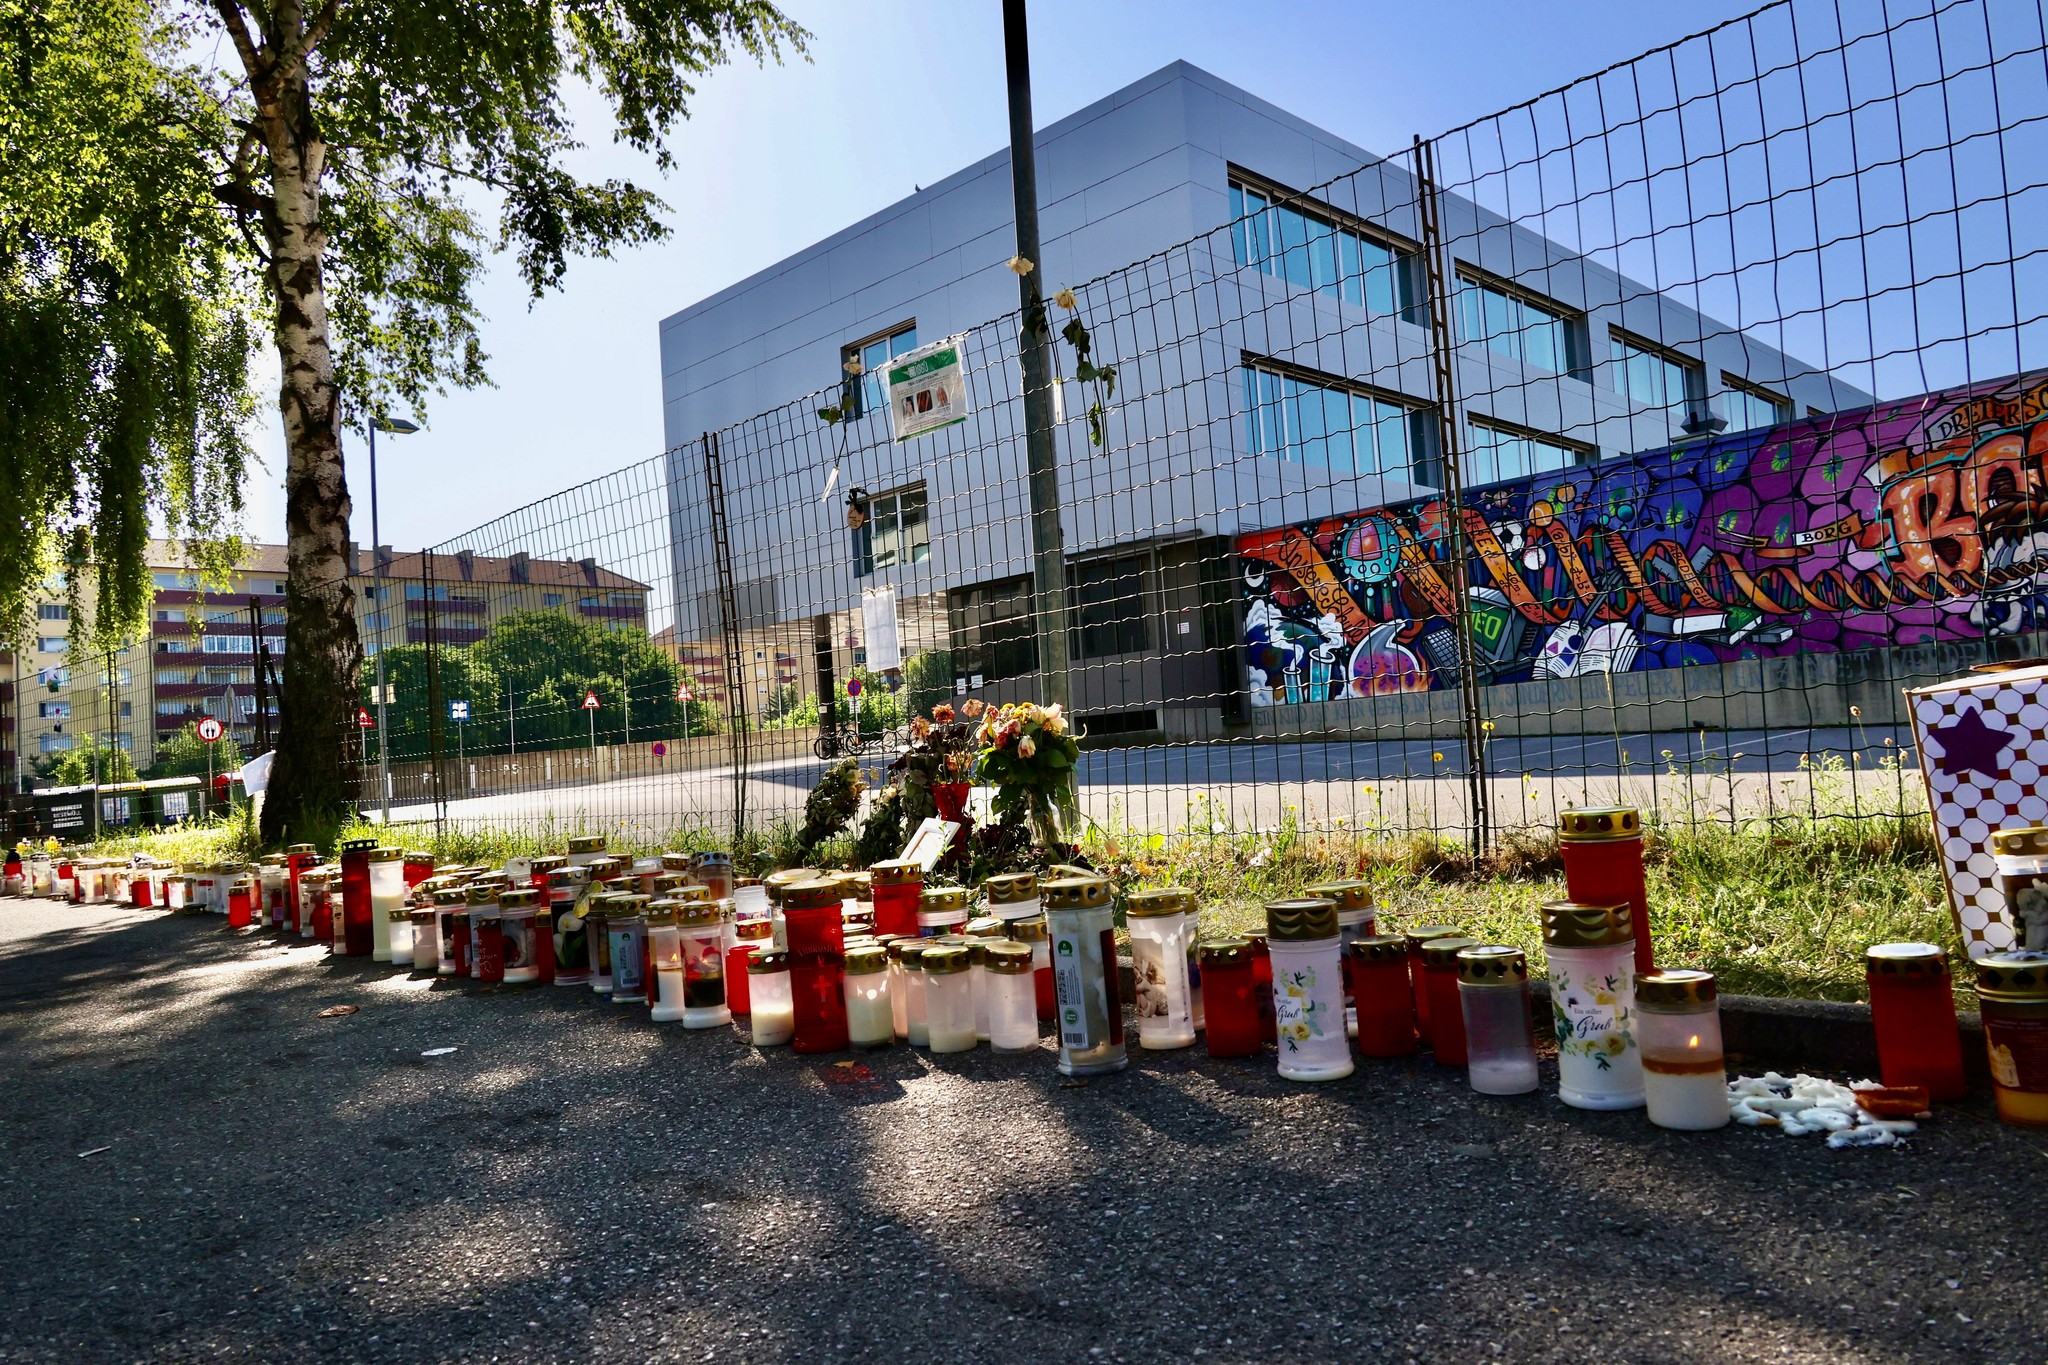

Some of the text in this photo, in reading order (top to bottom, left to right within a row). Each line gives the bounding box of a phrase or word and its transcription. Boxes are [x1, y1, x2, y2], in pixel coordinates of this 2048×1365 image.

[1801, 520, 1853, 543] BORG
[1278, 528, 1367, 643] Unsere Schule
[1471, 612, 1502, 641] EO
